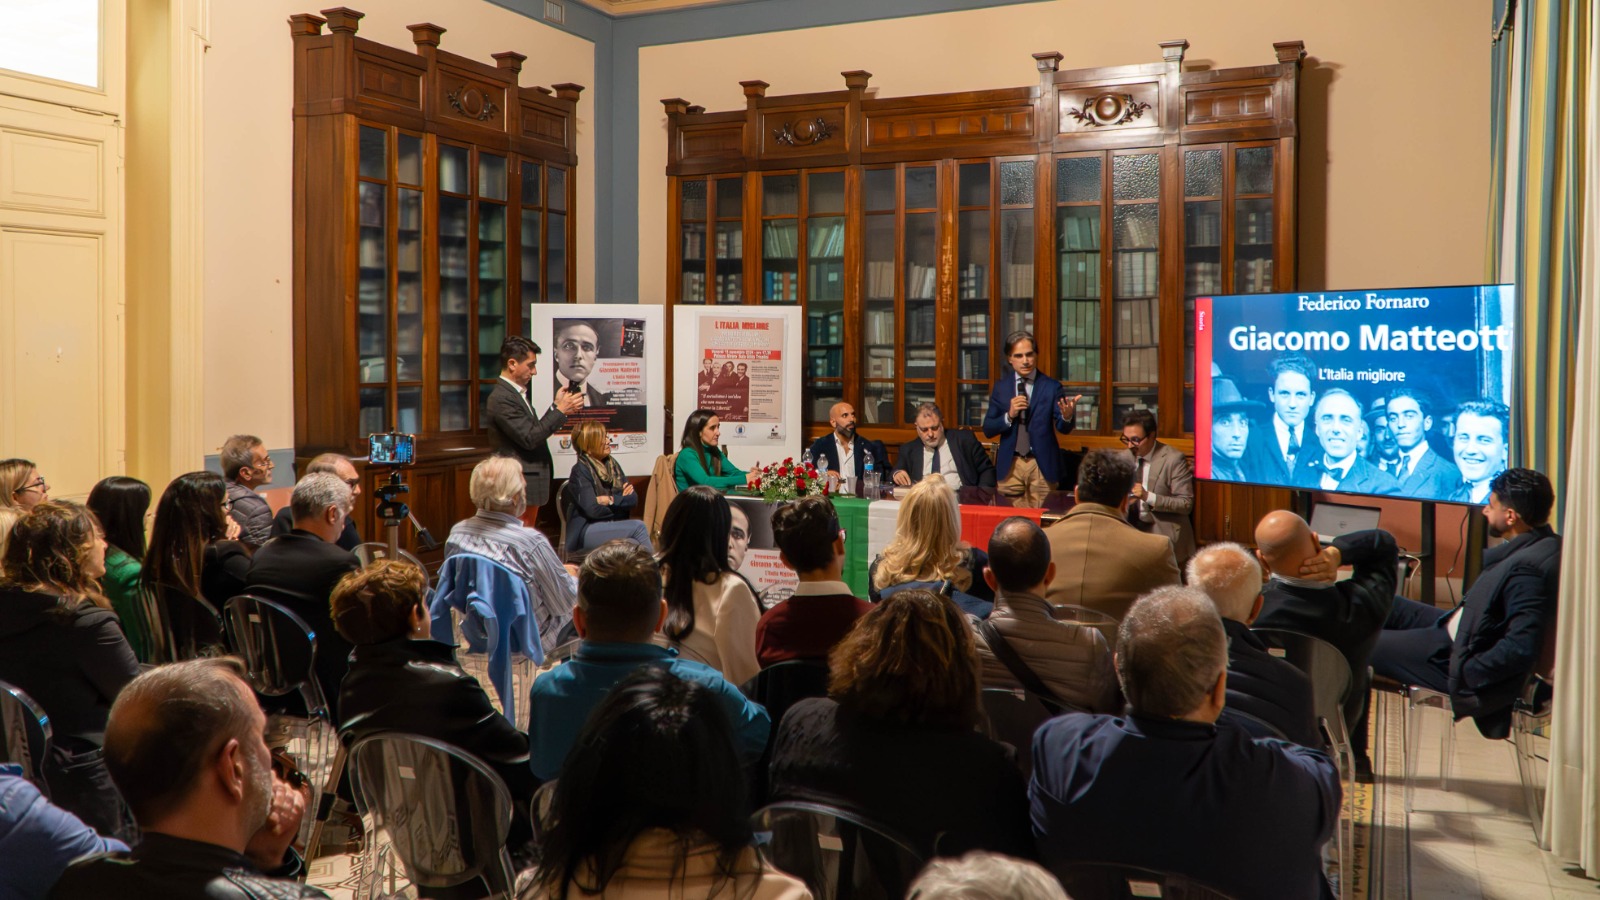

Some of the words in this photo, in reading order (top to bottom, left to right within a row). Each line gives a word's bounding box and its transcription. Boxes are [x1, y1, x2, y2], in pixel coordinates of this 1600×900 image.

[1298, 295, 1361, 312] Federico
[1365, 293, 1430, 310] Fornaro
[741, 321, 770, 331] MIGLIORE
[1228, 325, 1350, 351] Giacomo
[1318, 368, 1354, 381] L'Italia
[1356, 368, 1405, 384] migliore
